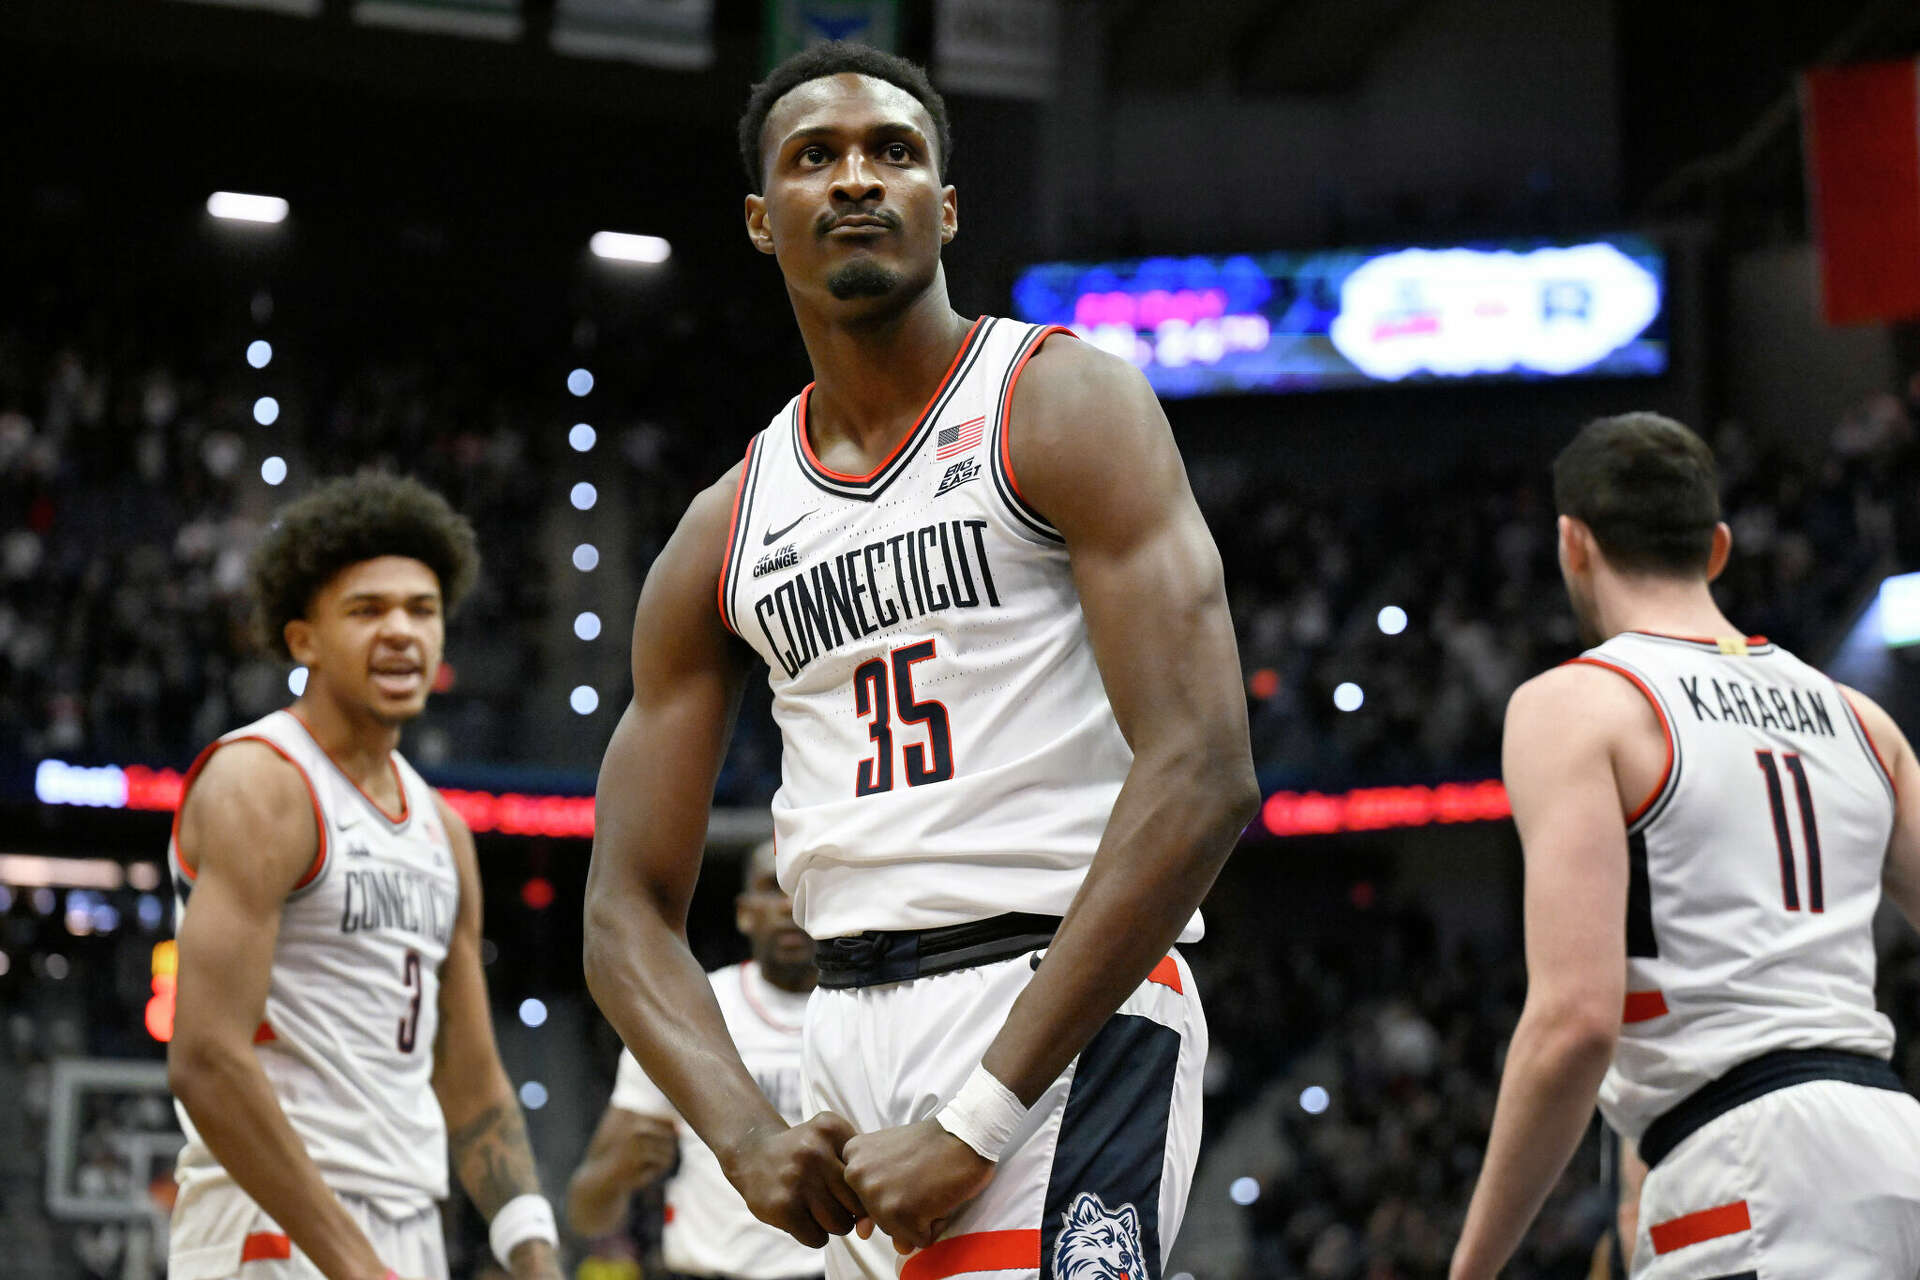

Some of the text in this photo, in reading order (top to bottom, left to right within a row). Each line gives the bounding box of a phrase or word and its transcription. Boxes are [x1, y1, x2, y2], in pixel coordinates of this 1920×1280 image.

[938, 464, 982, 491] EAST
[944, 456, 975, 478] BIG
[753, 552, 799, 578] CHANGE
[755, 520, 1001, 680] CONNECTICUT
[853, 638, 955, 798] 35
[1679, 675, 1836, 738] KARABAN
[1755, 749, 1824, 914] 11
[397, 947, 422, 1055] 3
